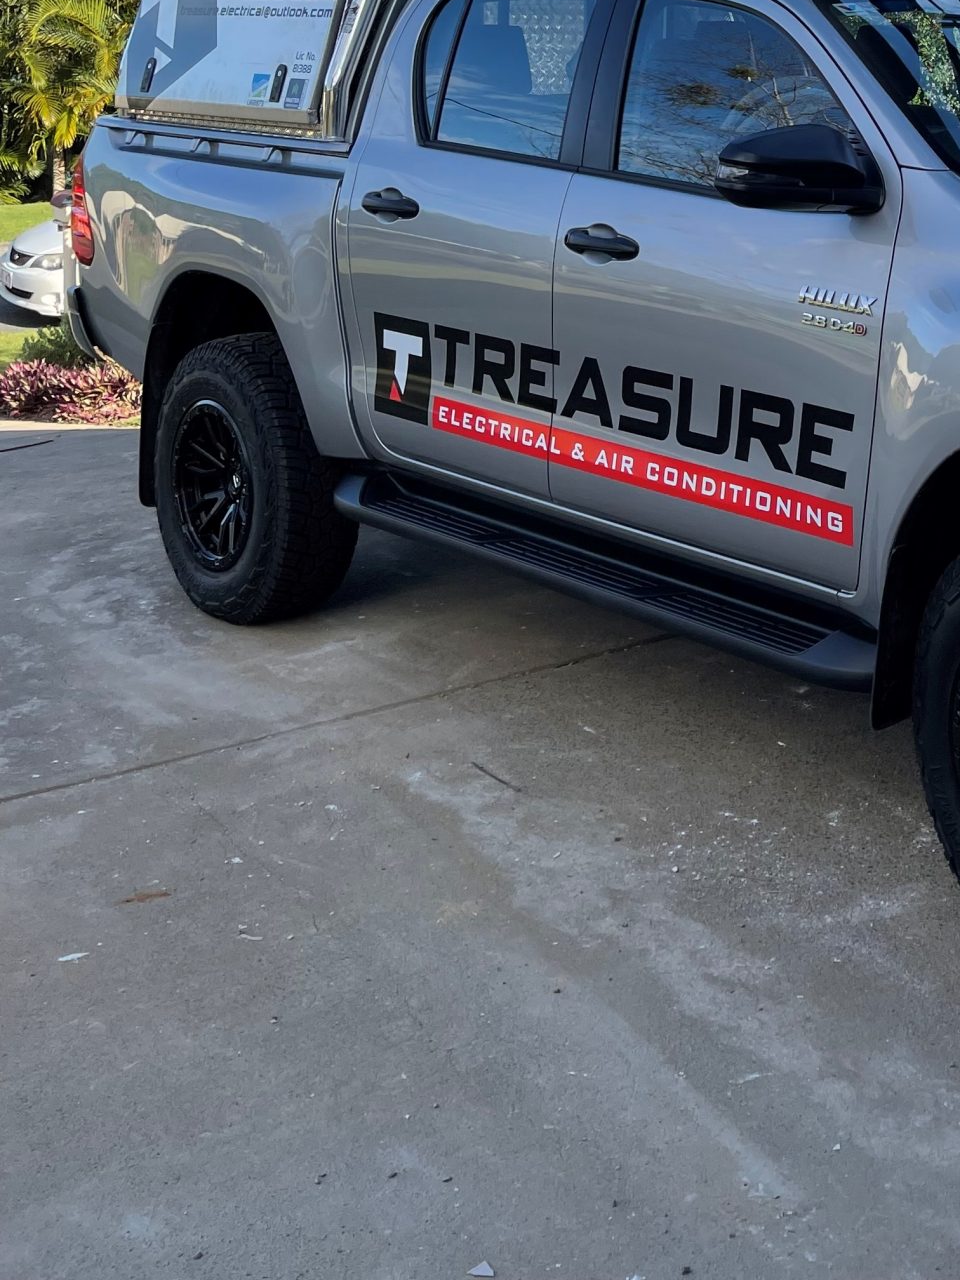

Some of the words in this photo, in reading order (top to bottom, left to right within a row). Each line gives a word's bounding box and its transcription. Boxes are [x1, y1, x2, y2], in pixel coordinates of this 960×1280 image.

[799, 285, 879, 317] HILUX
[434, 324, 855, 489] TREASURE
[439, 405, 561, 455] ELECTRICAL
[571, 441, 585, 462] &
[594, 448, 635, 475] AIR
[646, 462, 844, 534] CONDITIONING
